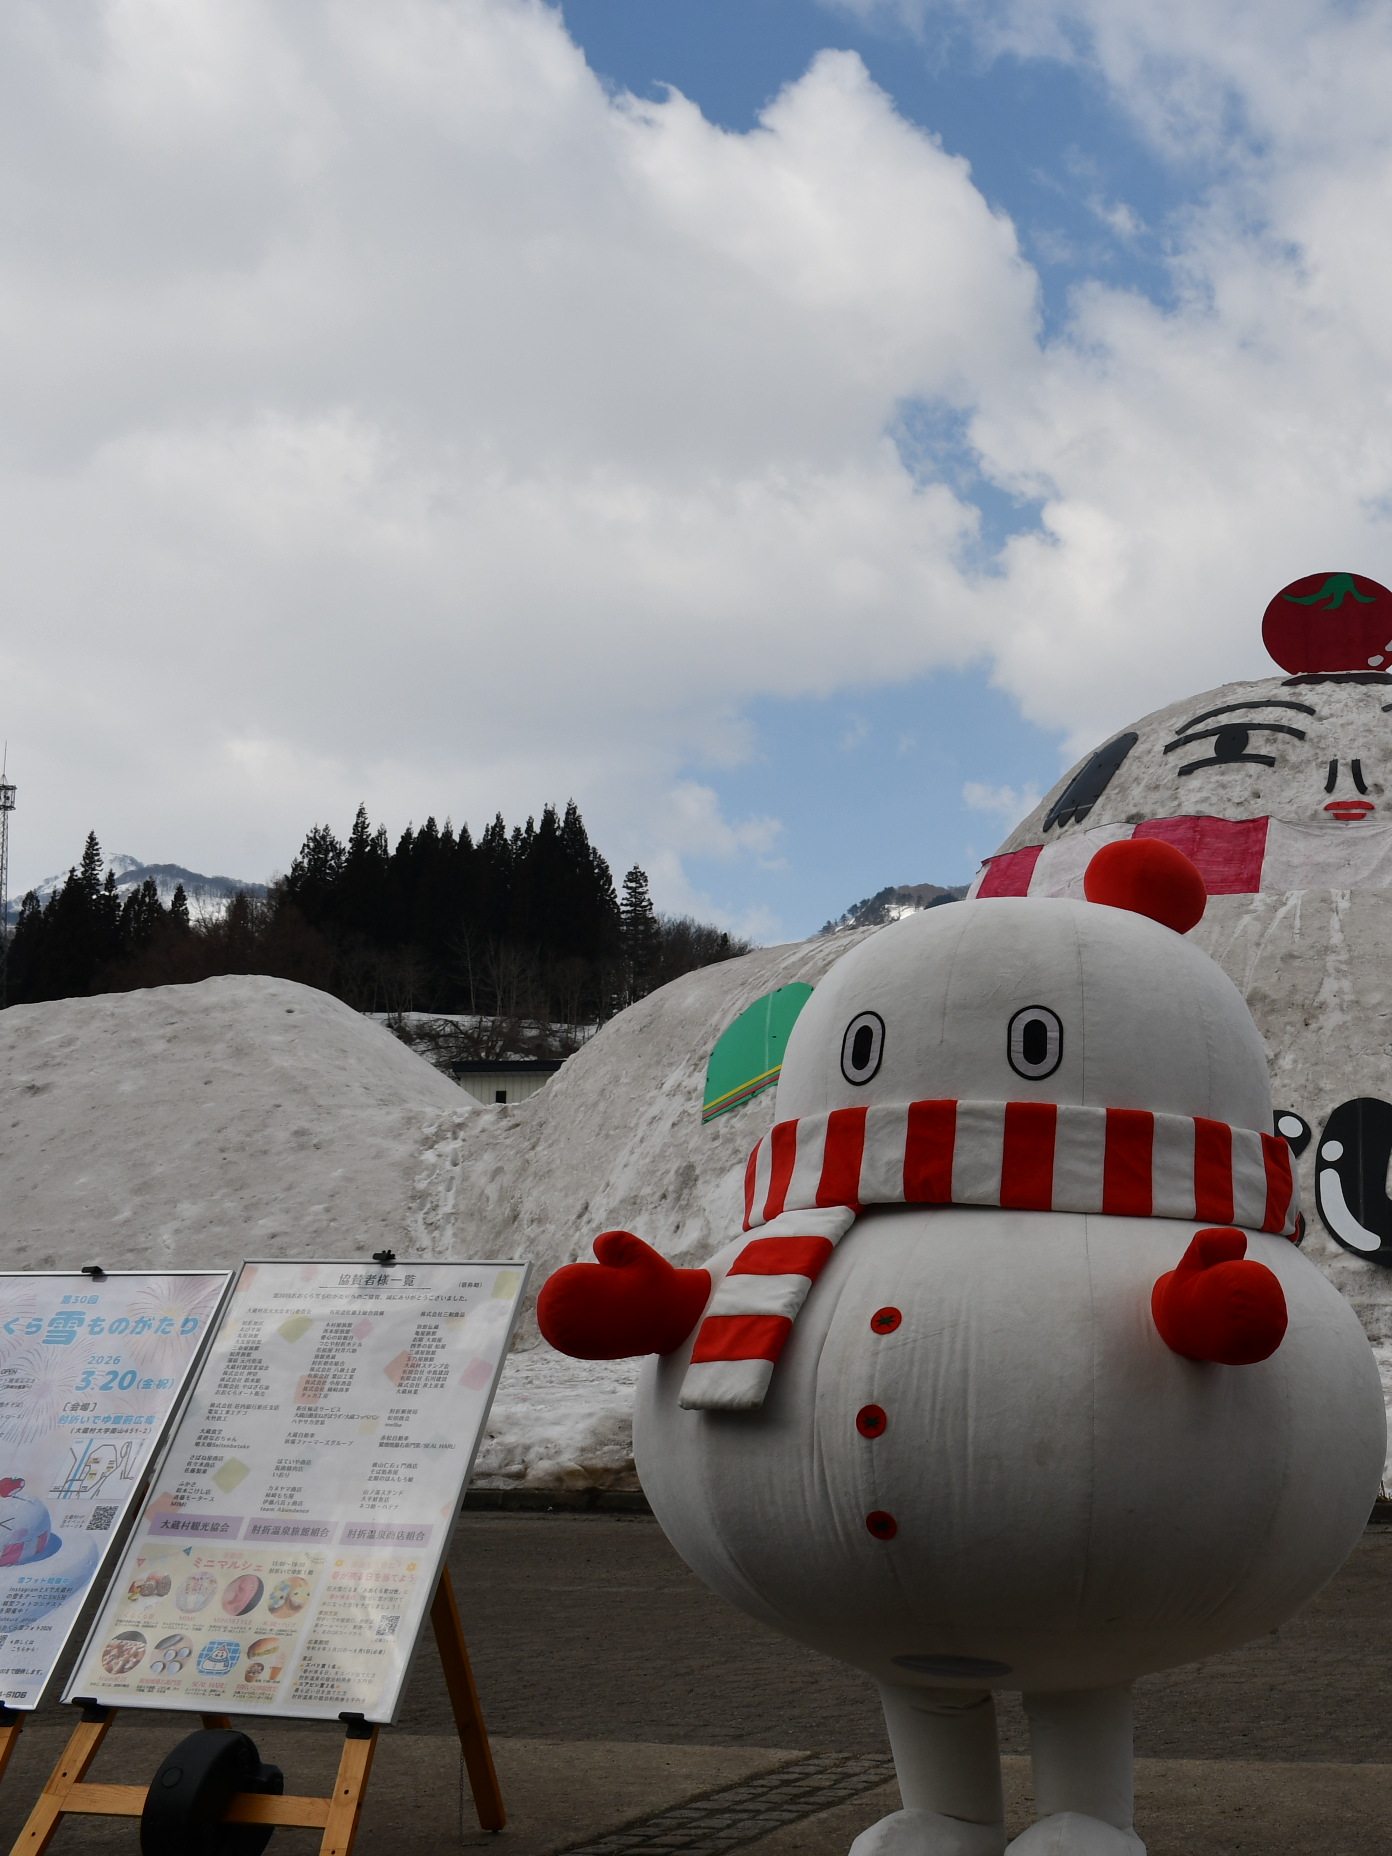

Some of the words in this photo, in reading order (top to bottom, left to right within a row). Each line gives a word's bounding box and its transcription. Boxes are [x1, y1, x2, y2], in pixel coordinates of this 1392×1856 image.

[338, 1273, 417, 1287] 協賛者様一覧
[60, 1294, 99, 1305] 第30回
[3, 1310, 199, 1346] くら雪ものがたり
[87, 1355, 121, 1365] 2026
[160, 1519, 230, 1533] 大蔵村観光協会
[251, 1524, 330, 1538] 肘折温泉旅館組合
[346, 1528, 426, 1542] 肘折温泉商店組合
[193, 1557, 263, 1572] ミニマルシェ
